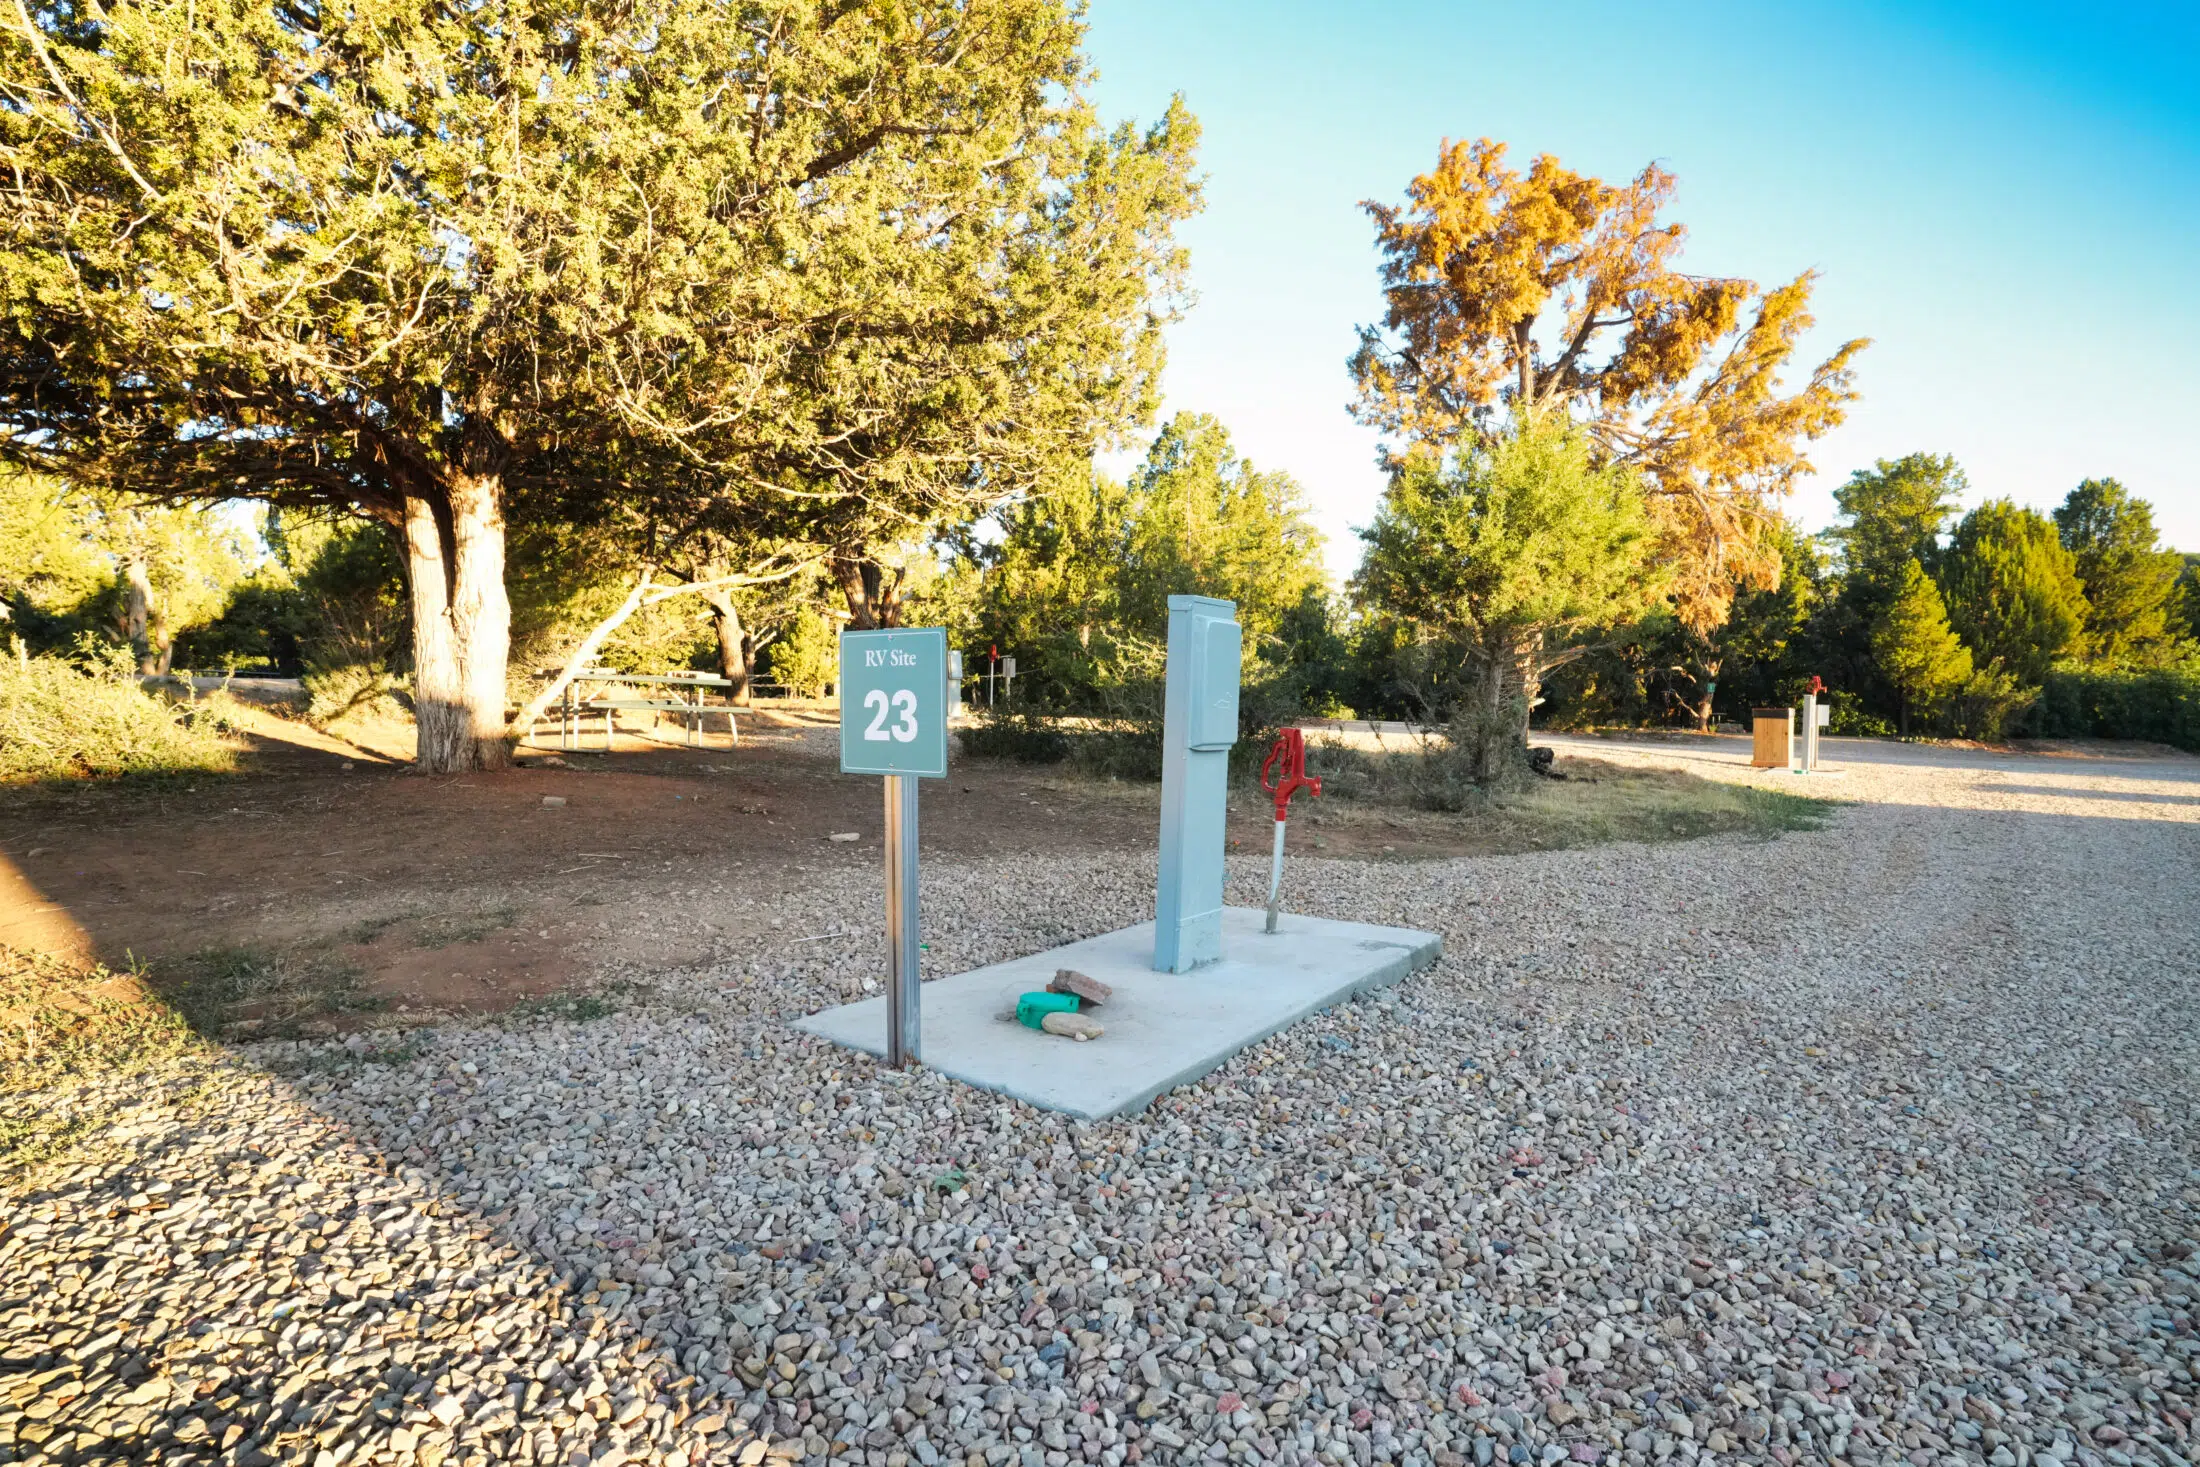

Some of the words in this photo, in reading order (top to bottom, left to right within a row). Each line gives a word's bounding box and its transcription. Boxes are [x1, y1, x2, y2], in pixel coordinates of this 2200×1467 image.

[865, 650, 887, 667] RV
[890, 649, 917, 666] Site
[863, 689, 919, 743] 23
